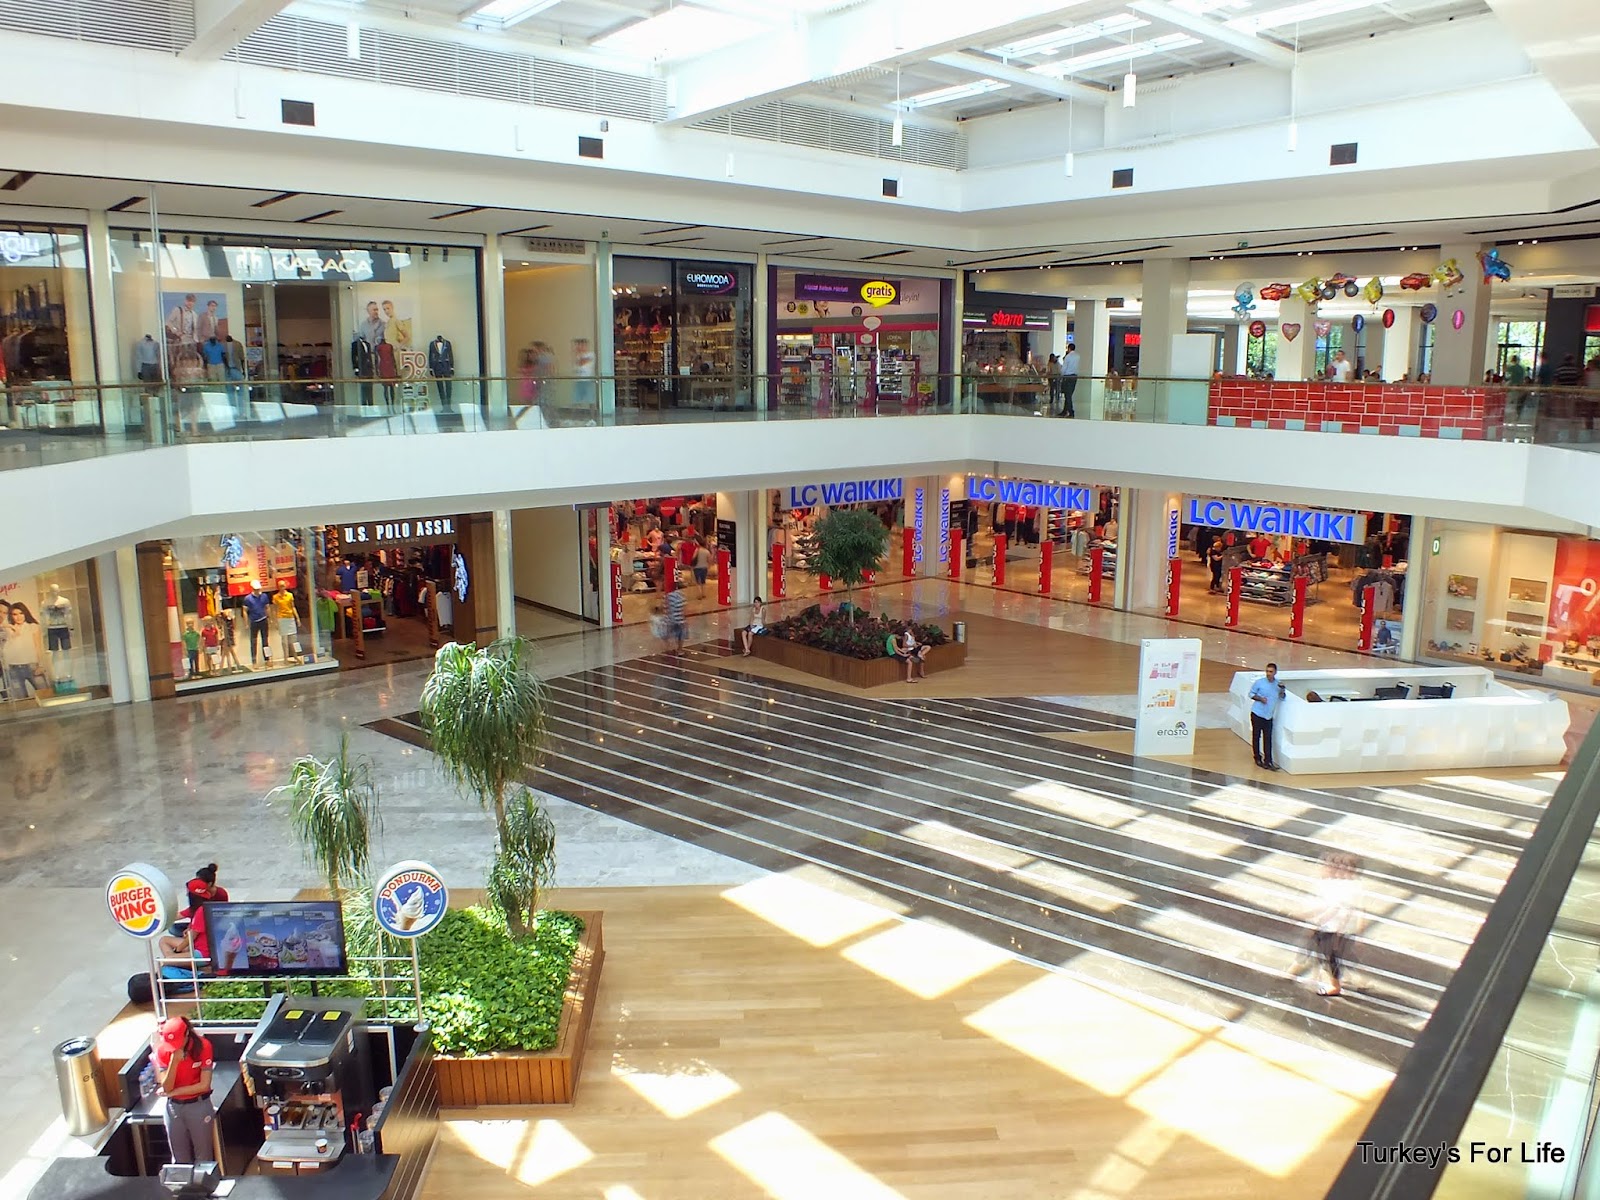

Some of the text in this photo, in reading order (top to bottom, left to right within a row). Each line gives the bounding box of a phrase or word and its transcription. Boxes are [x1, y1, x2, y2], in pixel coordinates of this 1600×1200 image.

[273, 256, 371, 273] KARACA
[686, 273, 729, 284] EUROMODA
[866, 284, 892, 298] gratis
[992, 310, 1023, 326] sbarro
[790, 485, 818, 507] LC
[969, 477, 996, 501] LC
[1190, 499, 1226, 526] LC
[344, 519, 455, 543] U.S. POLO ASSN.
[915, 544, 923, 562] LC
[940, 545, 949, 562] LC
[1157, 727, 1189, 737] erasta
[382, 872, 441, 898] DONDURMA
[110, 887, 152, 907] BURGER
[114, 898, 156, 922] KING
